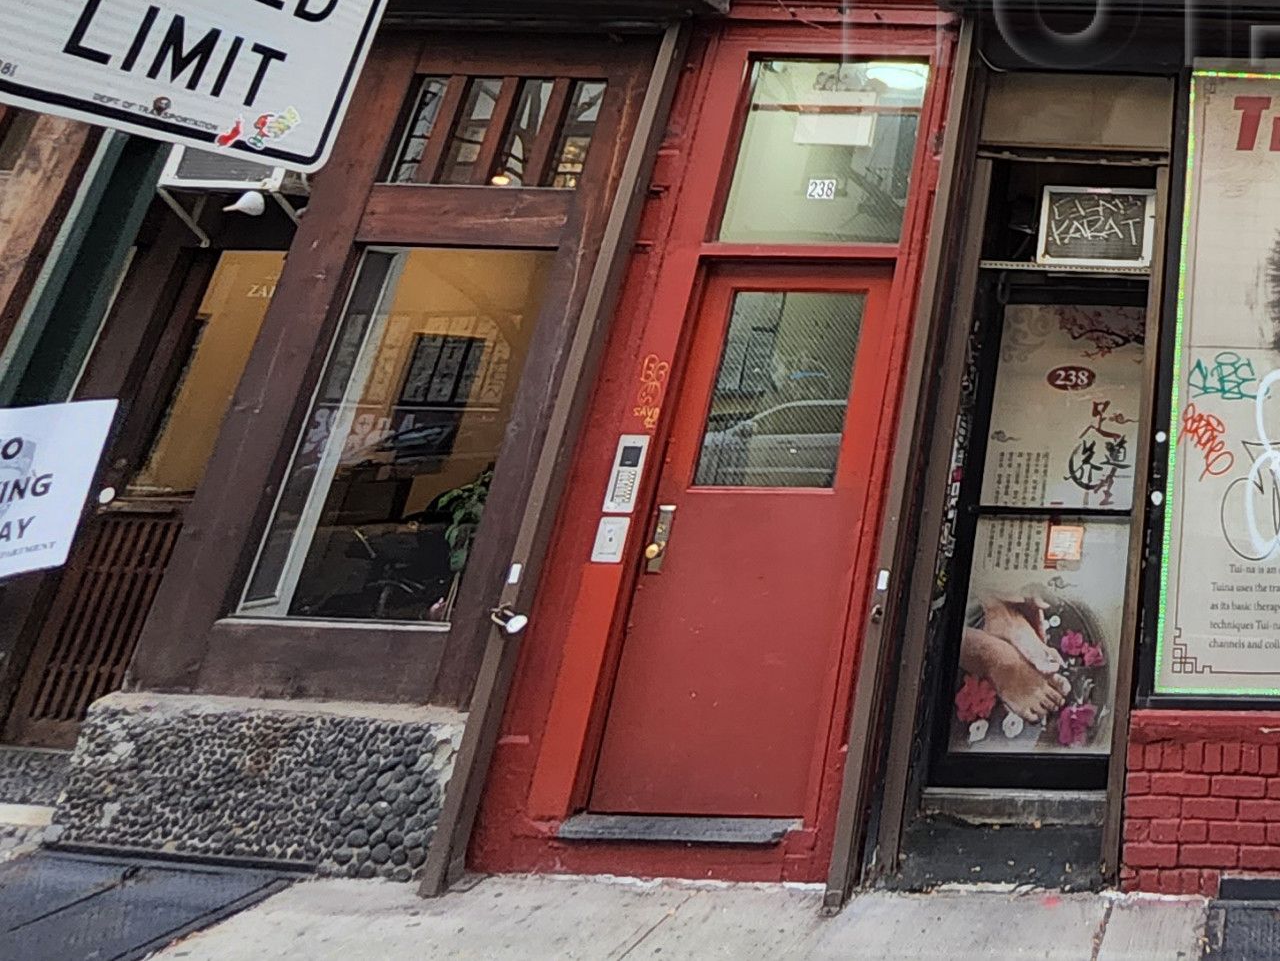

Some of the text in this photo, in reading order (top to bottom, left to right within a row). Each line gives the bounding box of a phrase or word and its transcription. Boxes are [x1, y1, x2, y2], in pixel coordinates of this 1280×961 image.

[807, 180, 835, 199] 238
[1054, 367, 1089, 387] 238
[1266, 566, 1277, 574] an
[1210, 582, 1234, 592] Tuina
[1254, 583, 1267, 592] the
[1210, 602, 1219, 610] as
[1231, 600, 1251, 610] basic
[1209, 619, 1254, 633] techniques
[1208, 638, 1246, 649] channels
[1247, 639, 1263, 649] and
